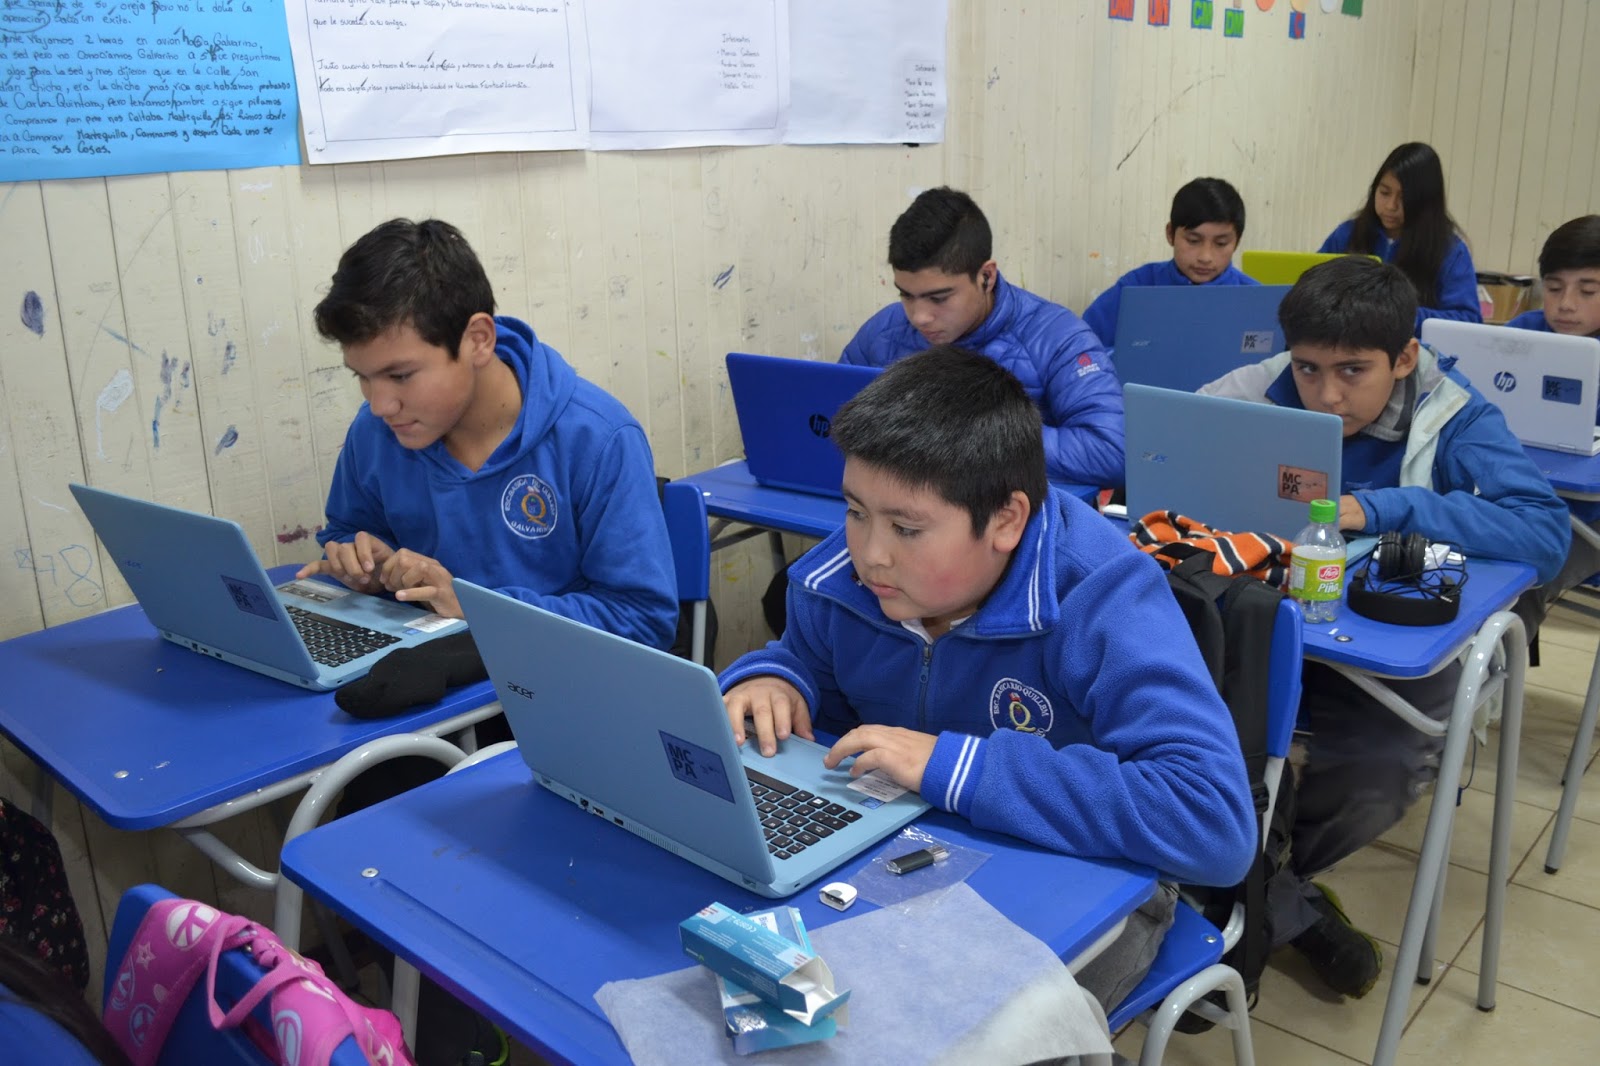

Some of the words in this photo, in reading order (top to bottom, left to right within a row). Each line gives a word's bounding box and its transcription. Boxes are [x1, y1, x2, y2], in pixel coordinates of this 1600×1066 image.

[98, 33, 123, 44] horas
[1282, 472, 1302, 485] MC
[1282, 483, 1299, 495] PA
[1317, 582, 1339, 593] Piña
[507, 681, 535, 699] acer
[667, 742, 694, 765] MC
[672, 757, 697, 779] PA
